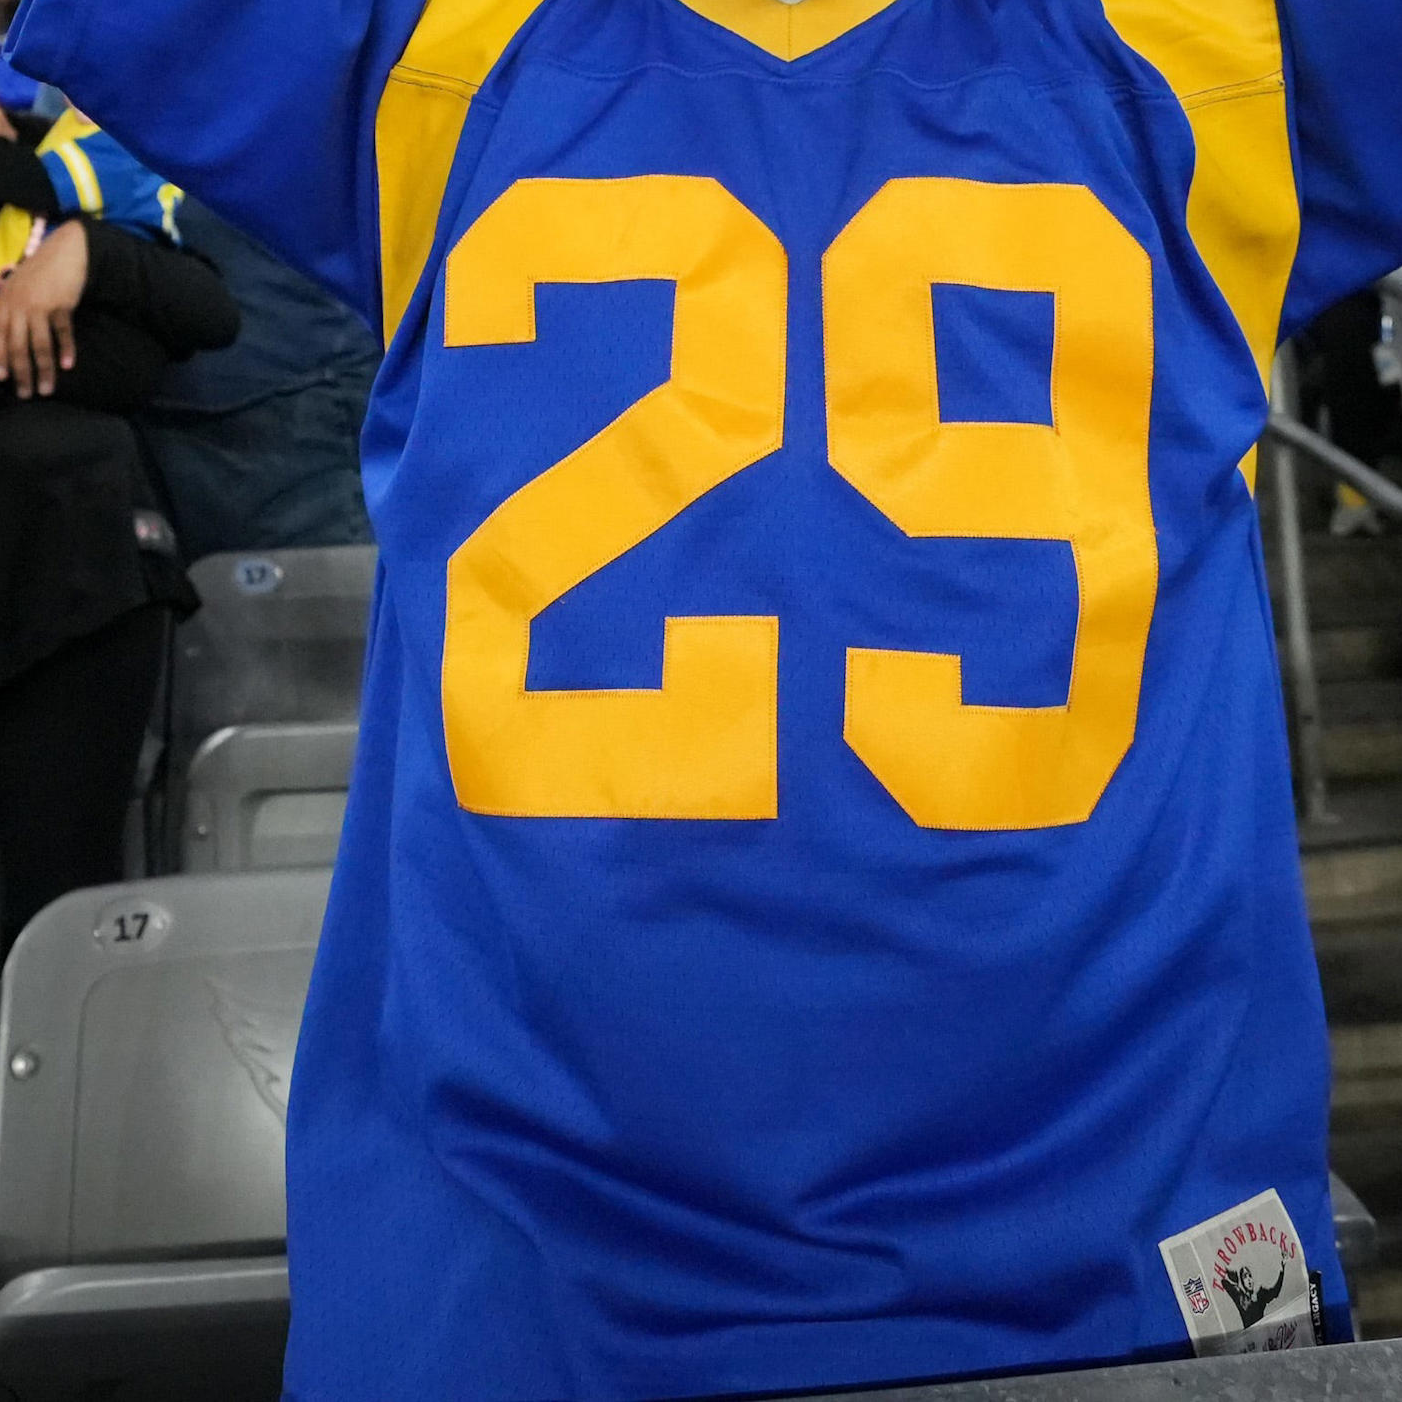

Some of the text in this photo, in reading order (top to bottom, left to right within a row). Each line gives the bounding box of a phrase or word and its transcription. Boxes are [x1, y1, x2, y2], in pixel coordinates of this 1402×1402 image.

[441, 173, 1160, 832] 29
[114, 912, 149, 943] 17
[1212, 1222, 1297, 1293] THROWBACKS
